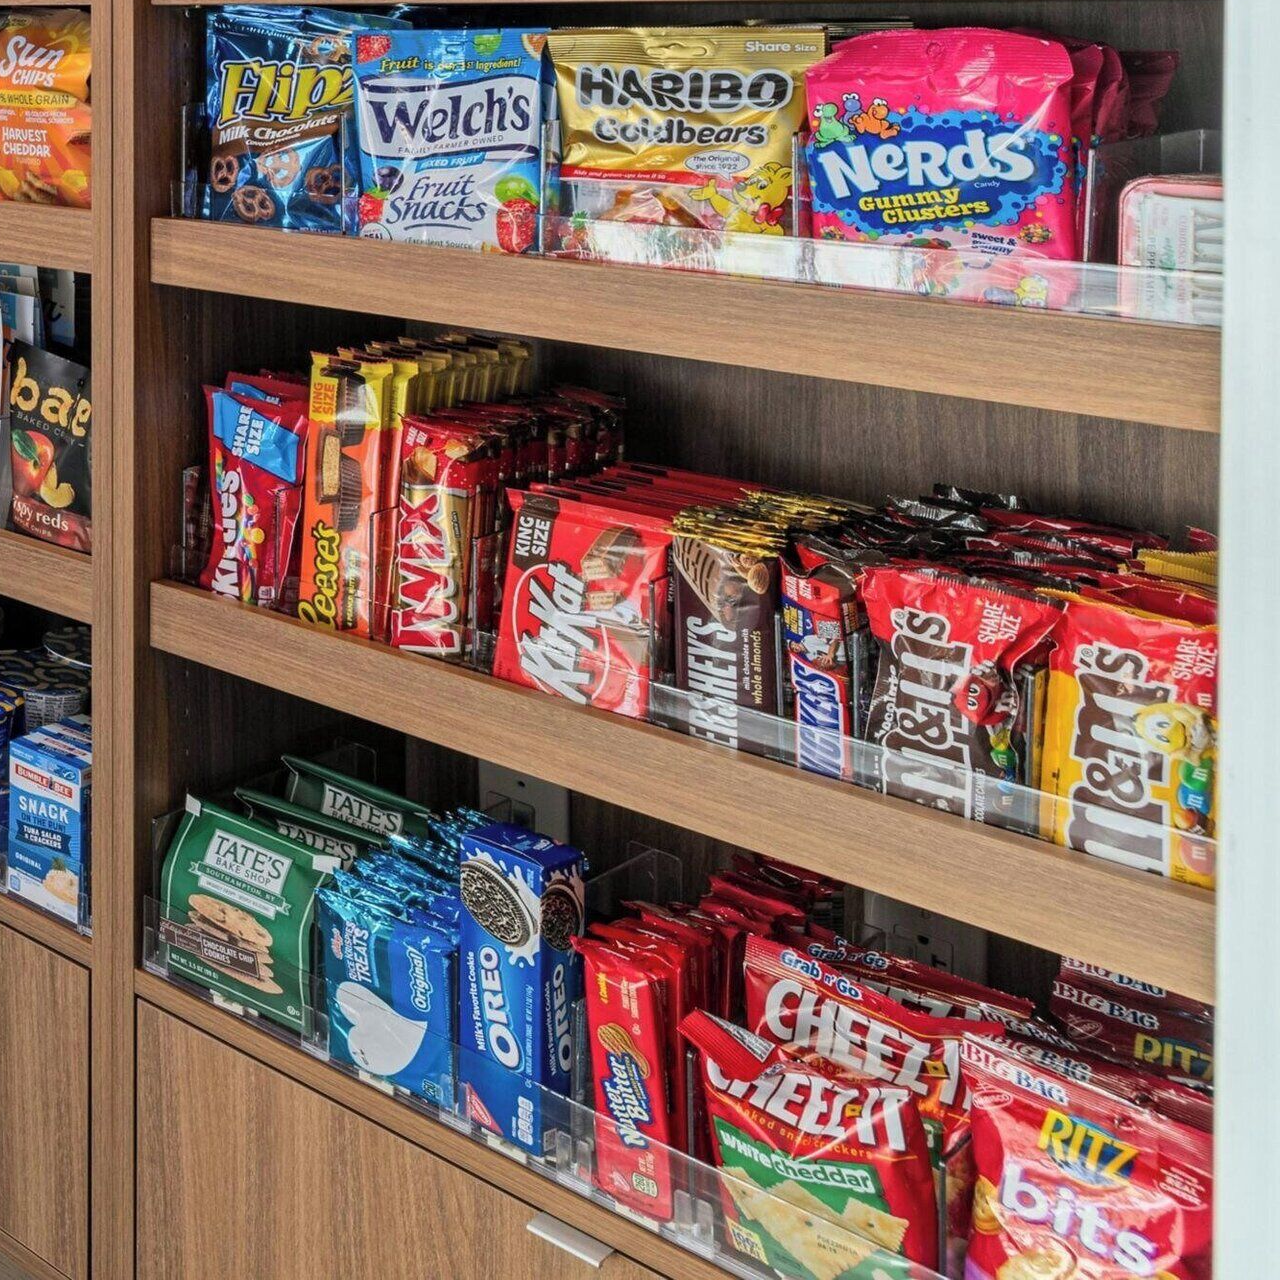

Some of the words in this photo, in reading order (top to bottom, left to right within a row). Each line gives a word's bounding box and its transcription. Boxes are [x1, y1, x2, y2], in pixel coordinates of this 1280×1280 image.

[744, 40, 792, 54] Share
[794, 42, 818, 53] Size
[12, 69, 56, 88] CHIPS
[578, 66, 790, 112] HARIBO
[5, 92, 34, 105] WHOLE
[35, 93, 70, 106] GRAIN
[367, 85, 532, 144] Welch's
[1, 125, 48, 142] HARVEST
[218, 125, 250, 146] Milk
[253, 113, 338, 140] Chocolate
[595, 116, 767, 147] Goldbears
[2, 141, 52, 159] CHEDDAR
[406, 175, 475, 202] Fruit
[857, 186, 961, 212] Gummy
[385, 196, 488, 224] Snacks
[881, 198, 990, 225] Clusters
[312, 381, 324, 415] KING
[322, 380, 336, 416] SIZE
[15, 410, 49, 433] BAKED
[231, 405, 254, 458] SHARE
[246, 419, 265, 457] SIZE
[513, 514, 532, 558] KING
[533, 515, 551, 558] SIZE
[977, 600, 1005, 645] SHARE
[998, 613, 1022, 642] SIZE
[753, 629, 762, 674] almonds
[1171, 637, 1200, 681] SHARE
[1193, 643, 1218, 678] SIZE
[753, 675, 762, 705] whole
[15, 764, 48, 787] BUMBLE
[53, 780, 73, 798] BEE
[18, 795, 70, 825] SNACK
[327, 788, 400, 833] TATE'S
[23, 824, 41, 837] TUNA
[41, 829, 62, 842] SALAD
[28, 834, 62, 850] CRACKERS
[209, 834, 286, 881] TATE'S
[215, 857, 243, 875] BAKE
[243, 869, 272, 886] SHOP
[203, 938, 239, 959] CHOCOLATE
[238, 954, 256, 965] CHIP
[203, 949, 231, 965] COOKIES
[352, 928, 371, 984] TREATS
[467, 950, 476, 983] Cookie
[409, 951, 428, 1011] Original
[780, 949, 821, 980] Grab
[835, 975, 861, 1000] Go
[471, 984, 483, 1024] Favorite
[480, 946, 522, 1070] OREO
[552, 962, 572, 1073] OREO
[1053, 980, 1108, 1013] BIG
[1108, 1002, 1159, 1030] BAG
[765, 978, 932, 1096] CHEEZ
[610, 1055, 650, 1126] Butter
[961, 1041, 1012, 1081] BIG
[1015, 1069, 1070, 1106] BAG
[1037, 1107, 1139, 1186] RITZ
[1001, 1160, 1157, 1275] bits
